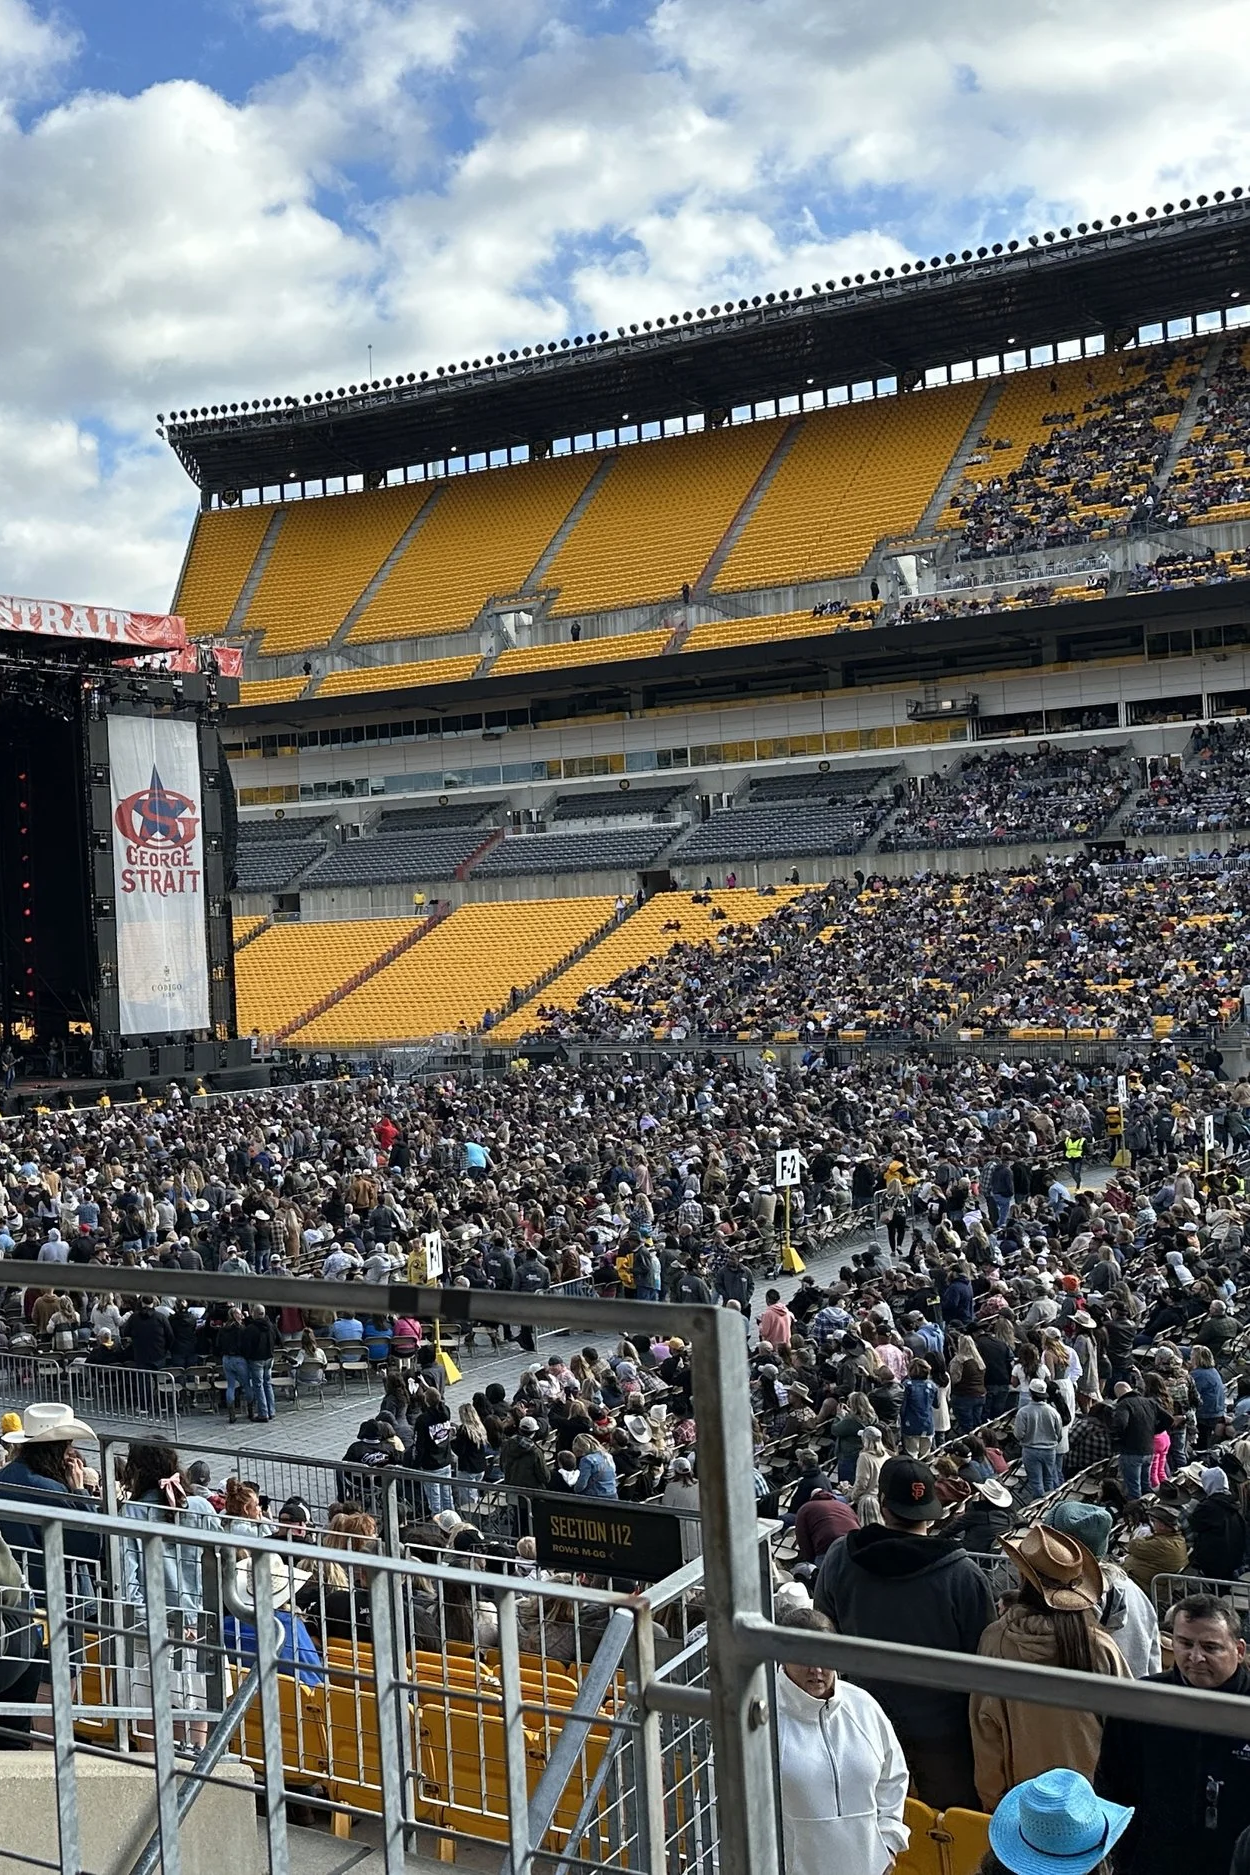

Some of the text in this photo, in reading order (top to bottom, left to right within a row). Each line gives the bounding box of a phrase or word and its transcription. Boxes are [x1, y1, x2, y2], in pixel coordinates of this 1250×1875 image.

[125, 844, 194, 869] GEORGE
[120, 868, 201, 898] STRAIT
[780, 1154, 797, 1181] F-2
[549, 1515, 633, 1547] SECTION 112
[552, 1543, 580, 1555] ROWS
